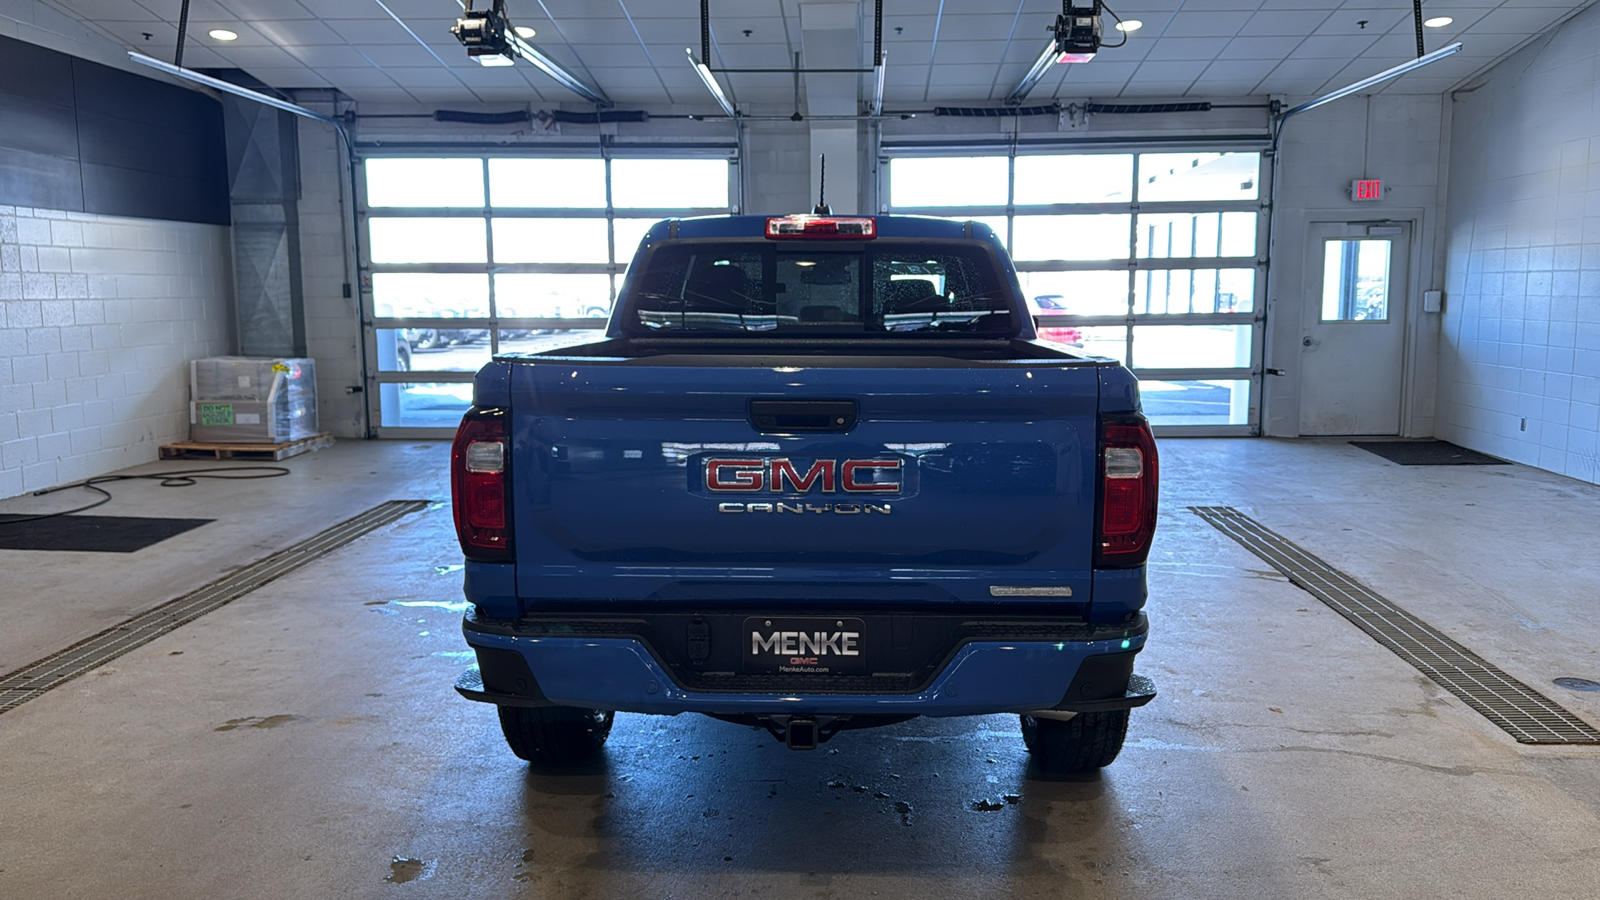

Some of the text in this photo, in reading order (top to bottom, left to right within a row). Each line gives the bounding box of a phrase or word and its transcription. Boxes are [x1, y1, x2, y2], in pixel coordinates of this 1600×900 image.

[1357, 180, 1380, 199] EXIT
[706, 457, 900, 492] GMC
[719, 502, 891, 513] CANYON
[752, 631, 859, 655] MENKE
